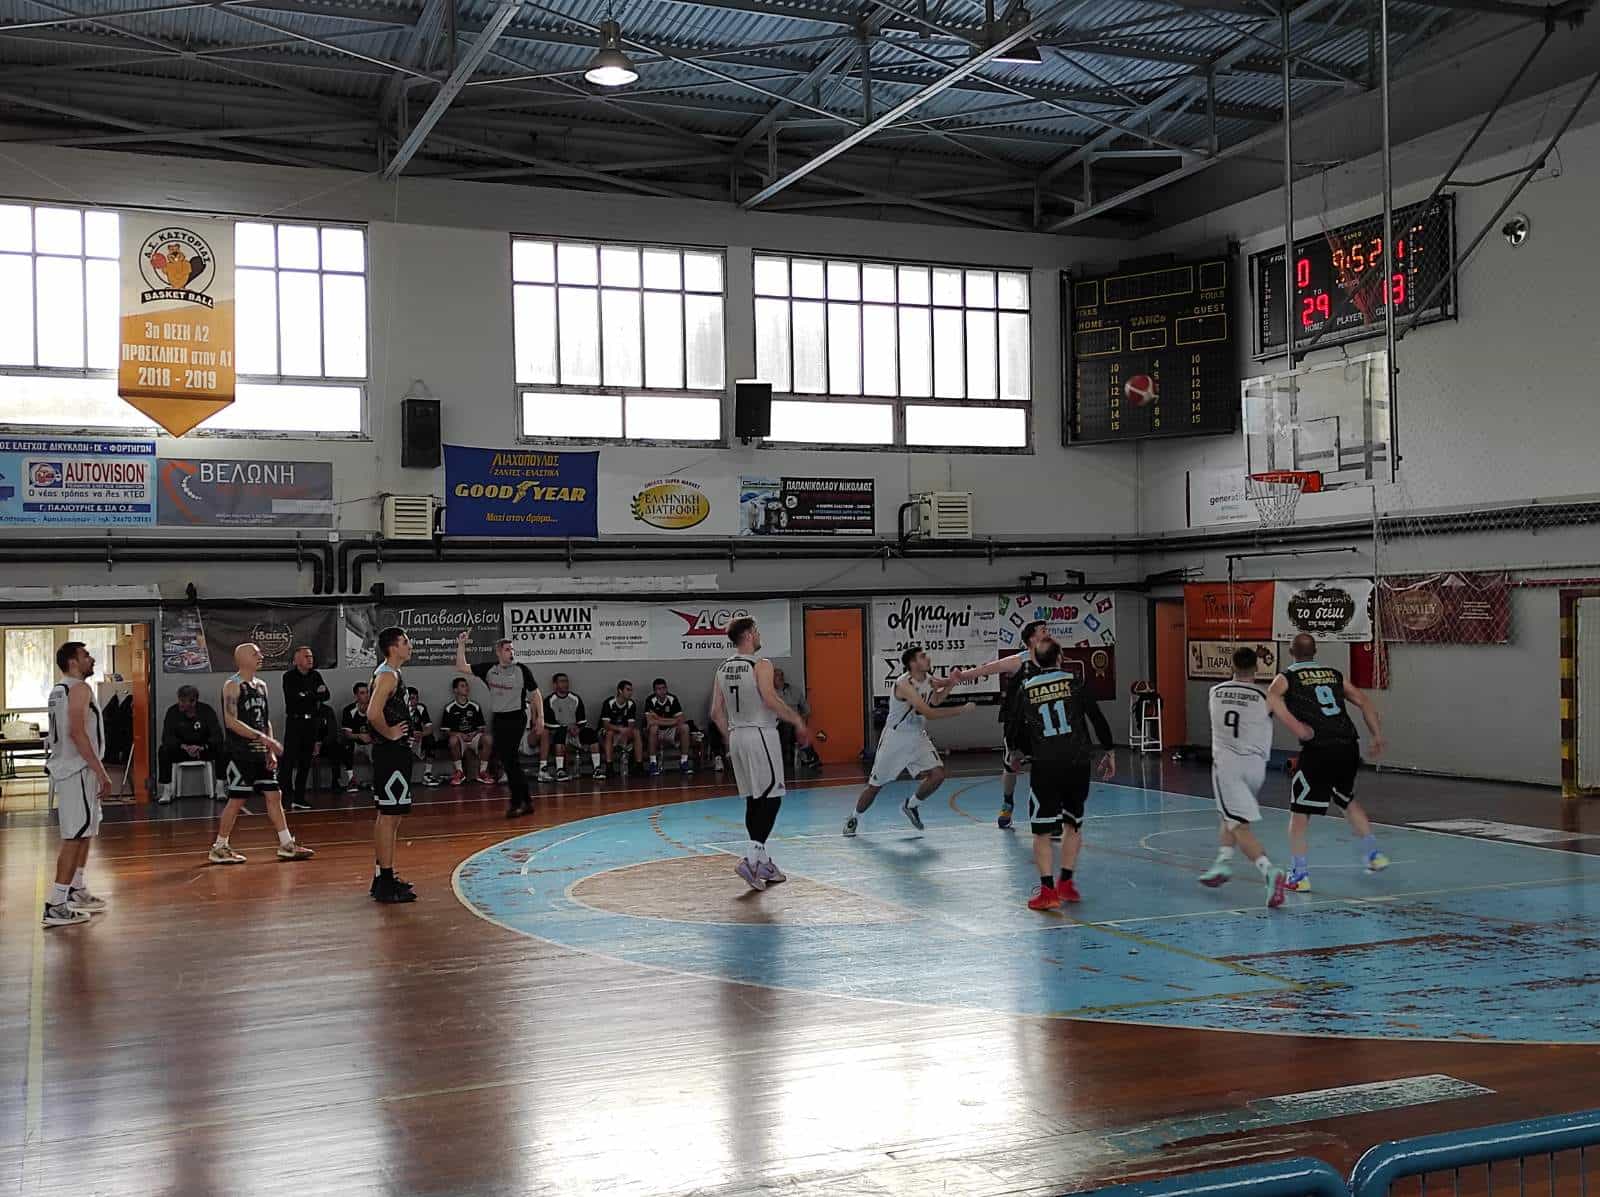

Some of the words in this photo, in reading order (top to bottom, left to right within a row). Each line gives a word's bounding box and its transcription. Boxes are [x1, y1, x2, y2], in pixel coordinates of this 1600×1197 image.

[158, 231, 211, 263] ΚΑΣΤΟΡΙΑΣ
[1297, 258, 1310, 288] 0
[145, 289, 186, 301] BASKET
[188, 291, 214, 308] BALL
[1193, 303, 1224, 315] GUEST
[1302, 293, 1329, 327] 29
[164, 322, 191, 341] ΘΕΣΗ
[122, 343, 187, 364] ΠΡΟΣΚΛΗΣΗ
[191, 350, 216, 367] στην
[138, 366, 170, 386] 2018
[185, 370, 216, 390] 2019
[65, 462, 145, 483] AUTOVISION
[200, 463, 295, 485] ΒΕΛΩΝΗ
[124, 490, 145, 498] ΚΤΕΟ
[786, 481, 838, 491] ΠΑΠΑΝΙΚΟΛΑΟΥ
[644, 495, 700, 505] ΕΛΛΗΝΙΚΗ
[644, 505, 700, 516] ΔΙΑΤΡΟΦΗ
[398, 608, 500, 626] Παπαβασιλείου
[511, 607, 592, 625] DAUWIN
[1033, 605, 1079, 621] JUMBO
[681, 640, 693, 650] Τα
[926, 641, 945, 651] 305
[947, 639, 966, 650] 333
[1029, 681, 1070, 698] ΠΑΟΚ
[730, 686, 743, 713] 7
[1314, 686, 1341, 717] 9
[1038, 699, 1072, 737] 11
[1224, 710, 1240, 739] 9
